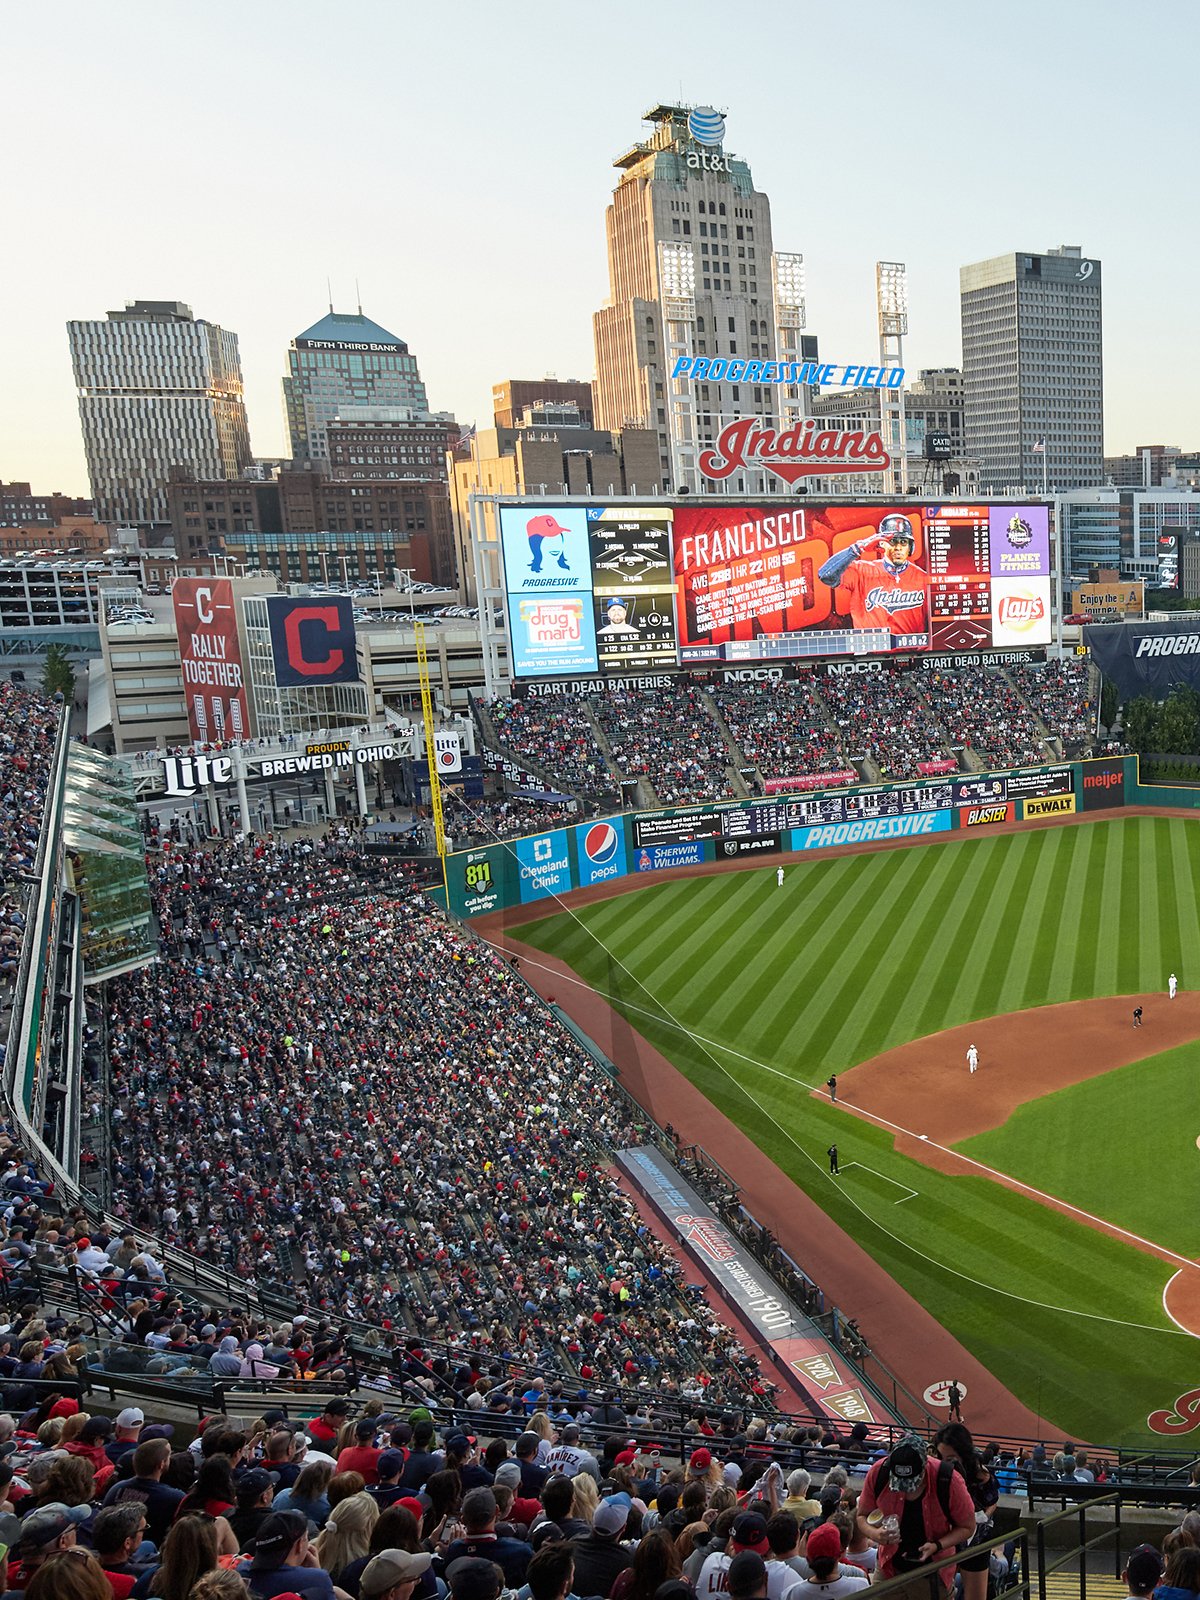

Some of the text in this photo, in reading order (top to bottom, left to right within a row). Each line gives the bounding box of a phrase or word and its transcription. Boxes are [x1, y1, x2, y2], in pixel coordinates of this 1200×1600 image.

[687, 150, 732, 173] at&t
[1079, 261, 1094, 281] 9
[307, 340, 397, 352] FIFTH THIRD BANK
[671, 356, 905, 388] PROGRESSIVE FIELD
[698, 417, 891, 486] Indians
[682, 509, 806, 570] FRANCISCO
[1000, 553, 1040, 563] PLANET
[1000, 561, 1041, 571] FITNESS
[522, 577, 579, 587] PROGRESSIVE
[692, 554, 781, 590] AVG HR 22 RBI
[195, 588, 214, 624] C
[865, 584, 925, 615] Indians
[1001, 596, 1043, 622] Lay's
[1080, 594, 1117, 606] Enjoy the
[531, 606, 569, 628] drug
[538, 618, 581, 641] mart
[191, 633, 226, 660] RALLY
[284, 606, 345, 676] C
[183, 658, 243, 688] TOGETHER
[827, 661, 882, 676] NOCO
[922, 656, 954, 670] START
[954, 654, 979, 667] DEAD
[528, 675, 675, 696] START DEAD BATTERIES.
[724, 667, 783, 684] NOCO
[307, 740, 351, 755] PROUDLY
[261, 745, 394, 777] BREWED IN OHIO
[161, 756, 231, 796] Lite
[1083, 770, 1123, 790] meijer
[967, 806, 1007, 827] BLASTER
[805, 813, 936, 849] PROGRESSIVE
[654, 845, 698, 859] SHERWIN
[740, 839, 775, 850] RAM
[466, 862, 491, 885] 811
[521, 857, 568, 879] Cleveland
[590, 863, 618, 882] pepsi
[532, 874, 560, 889] Clinic
[464, 894, 497, 907] Call before
[470, 904, 482, 914] you
[676, 1214, 737, 1262] Indians
[724, 1260, 796, 1330] ESTABLISHED 1901
[804, 1358, 834, 1380] 1920
[834, 1394, 866, 1420] 1948
